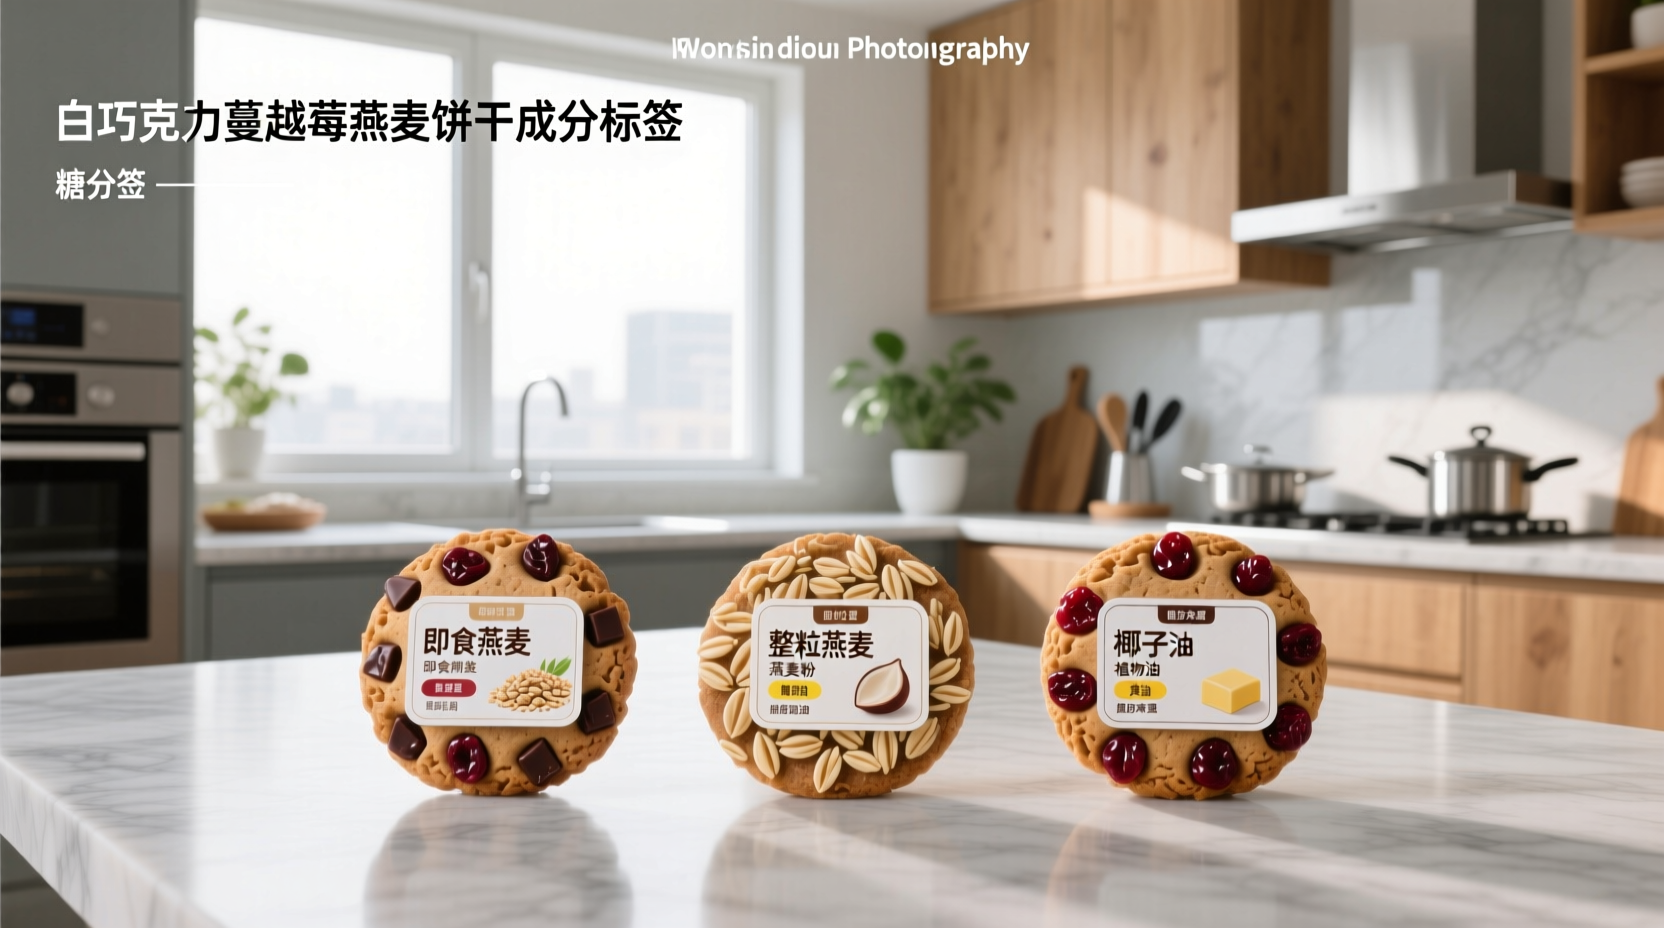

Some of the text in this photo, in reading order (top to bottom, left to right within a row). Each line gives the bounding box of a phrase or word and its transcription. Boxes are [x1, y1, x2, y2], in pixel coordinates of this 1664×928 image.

[423, 626, 531, 657] 即食燕麦
[768, 629, 874, 660] 整粒燕麦
[1113, 629, 1194, 658] 椰子油
